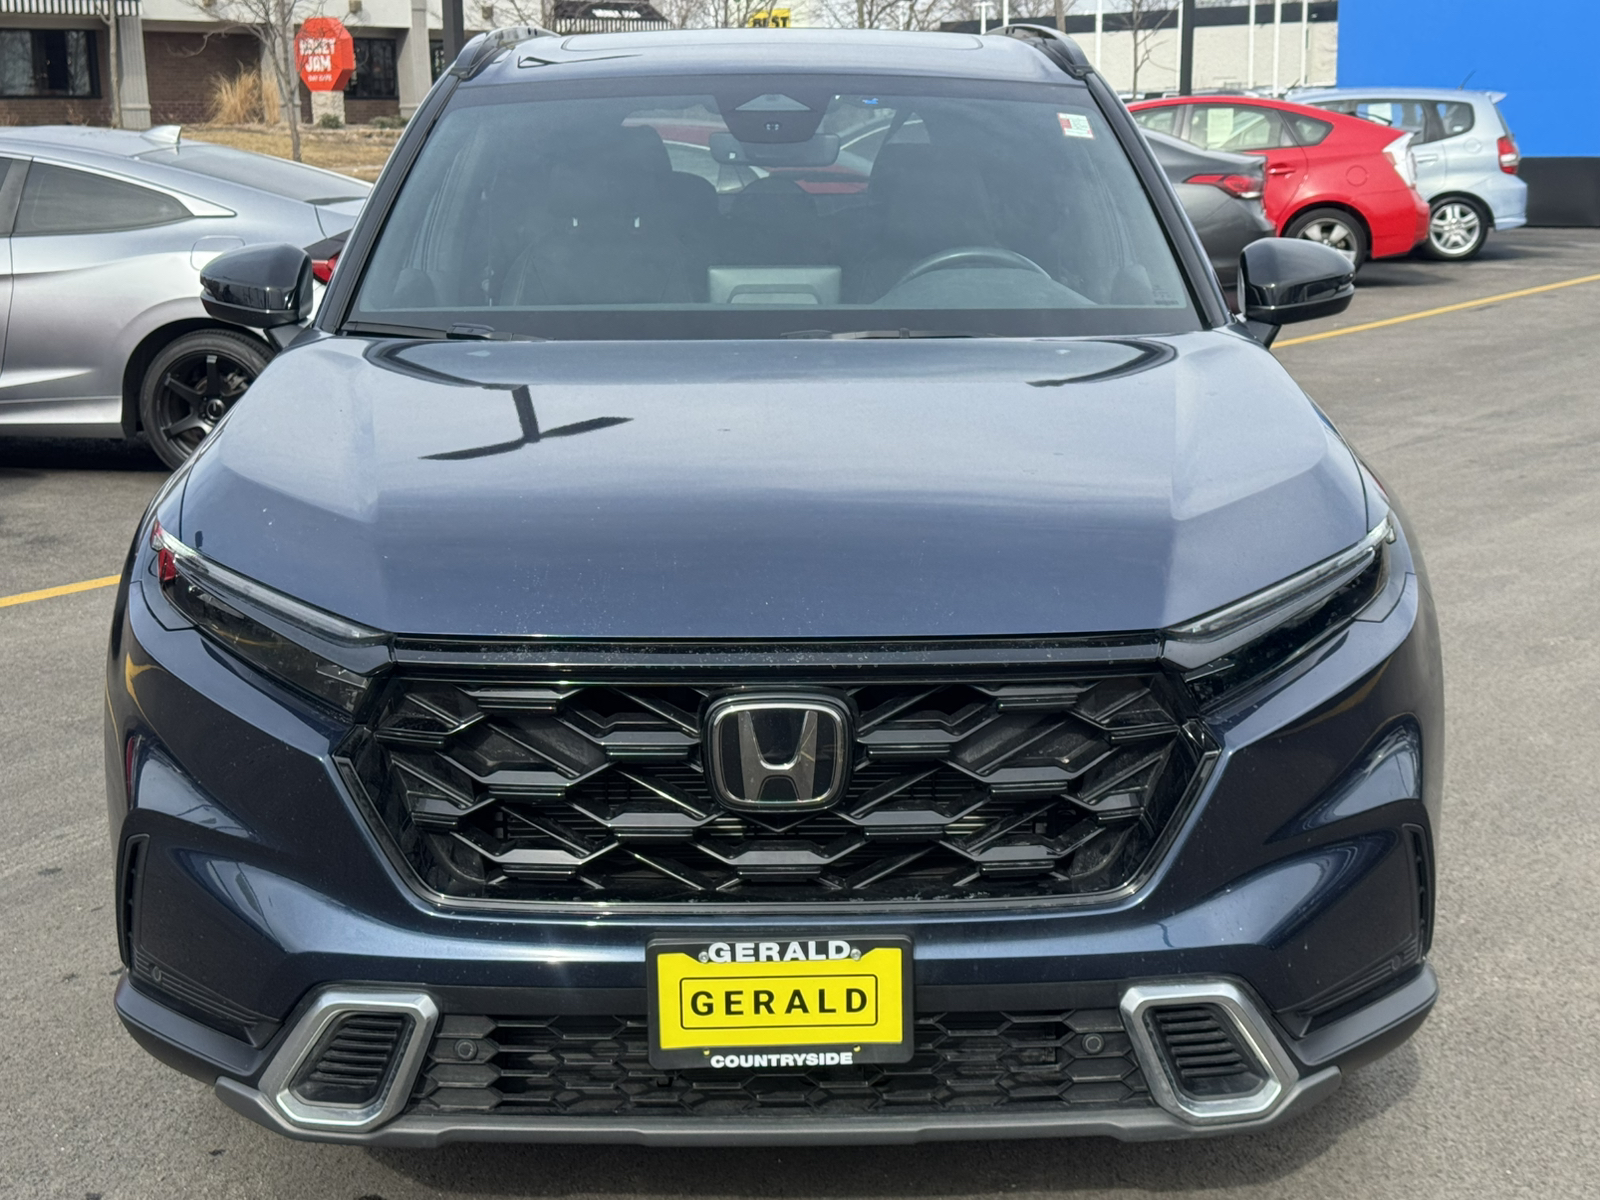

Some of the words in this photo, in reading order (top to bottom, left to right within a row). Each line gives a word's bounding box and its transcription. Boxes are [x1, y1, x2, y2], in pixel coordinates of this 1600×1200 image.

[305, 55, 332, 72] JAM
[708, 940, 851, 963] GERALD
[690, 988, 868, 1016] GERALD
[710, 1052, 853, 1068] COUNTRYSIDE
